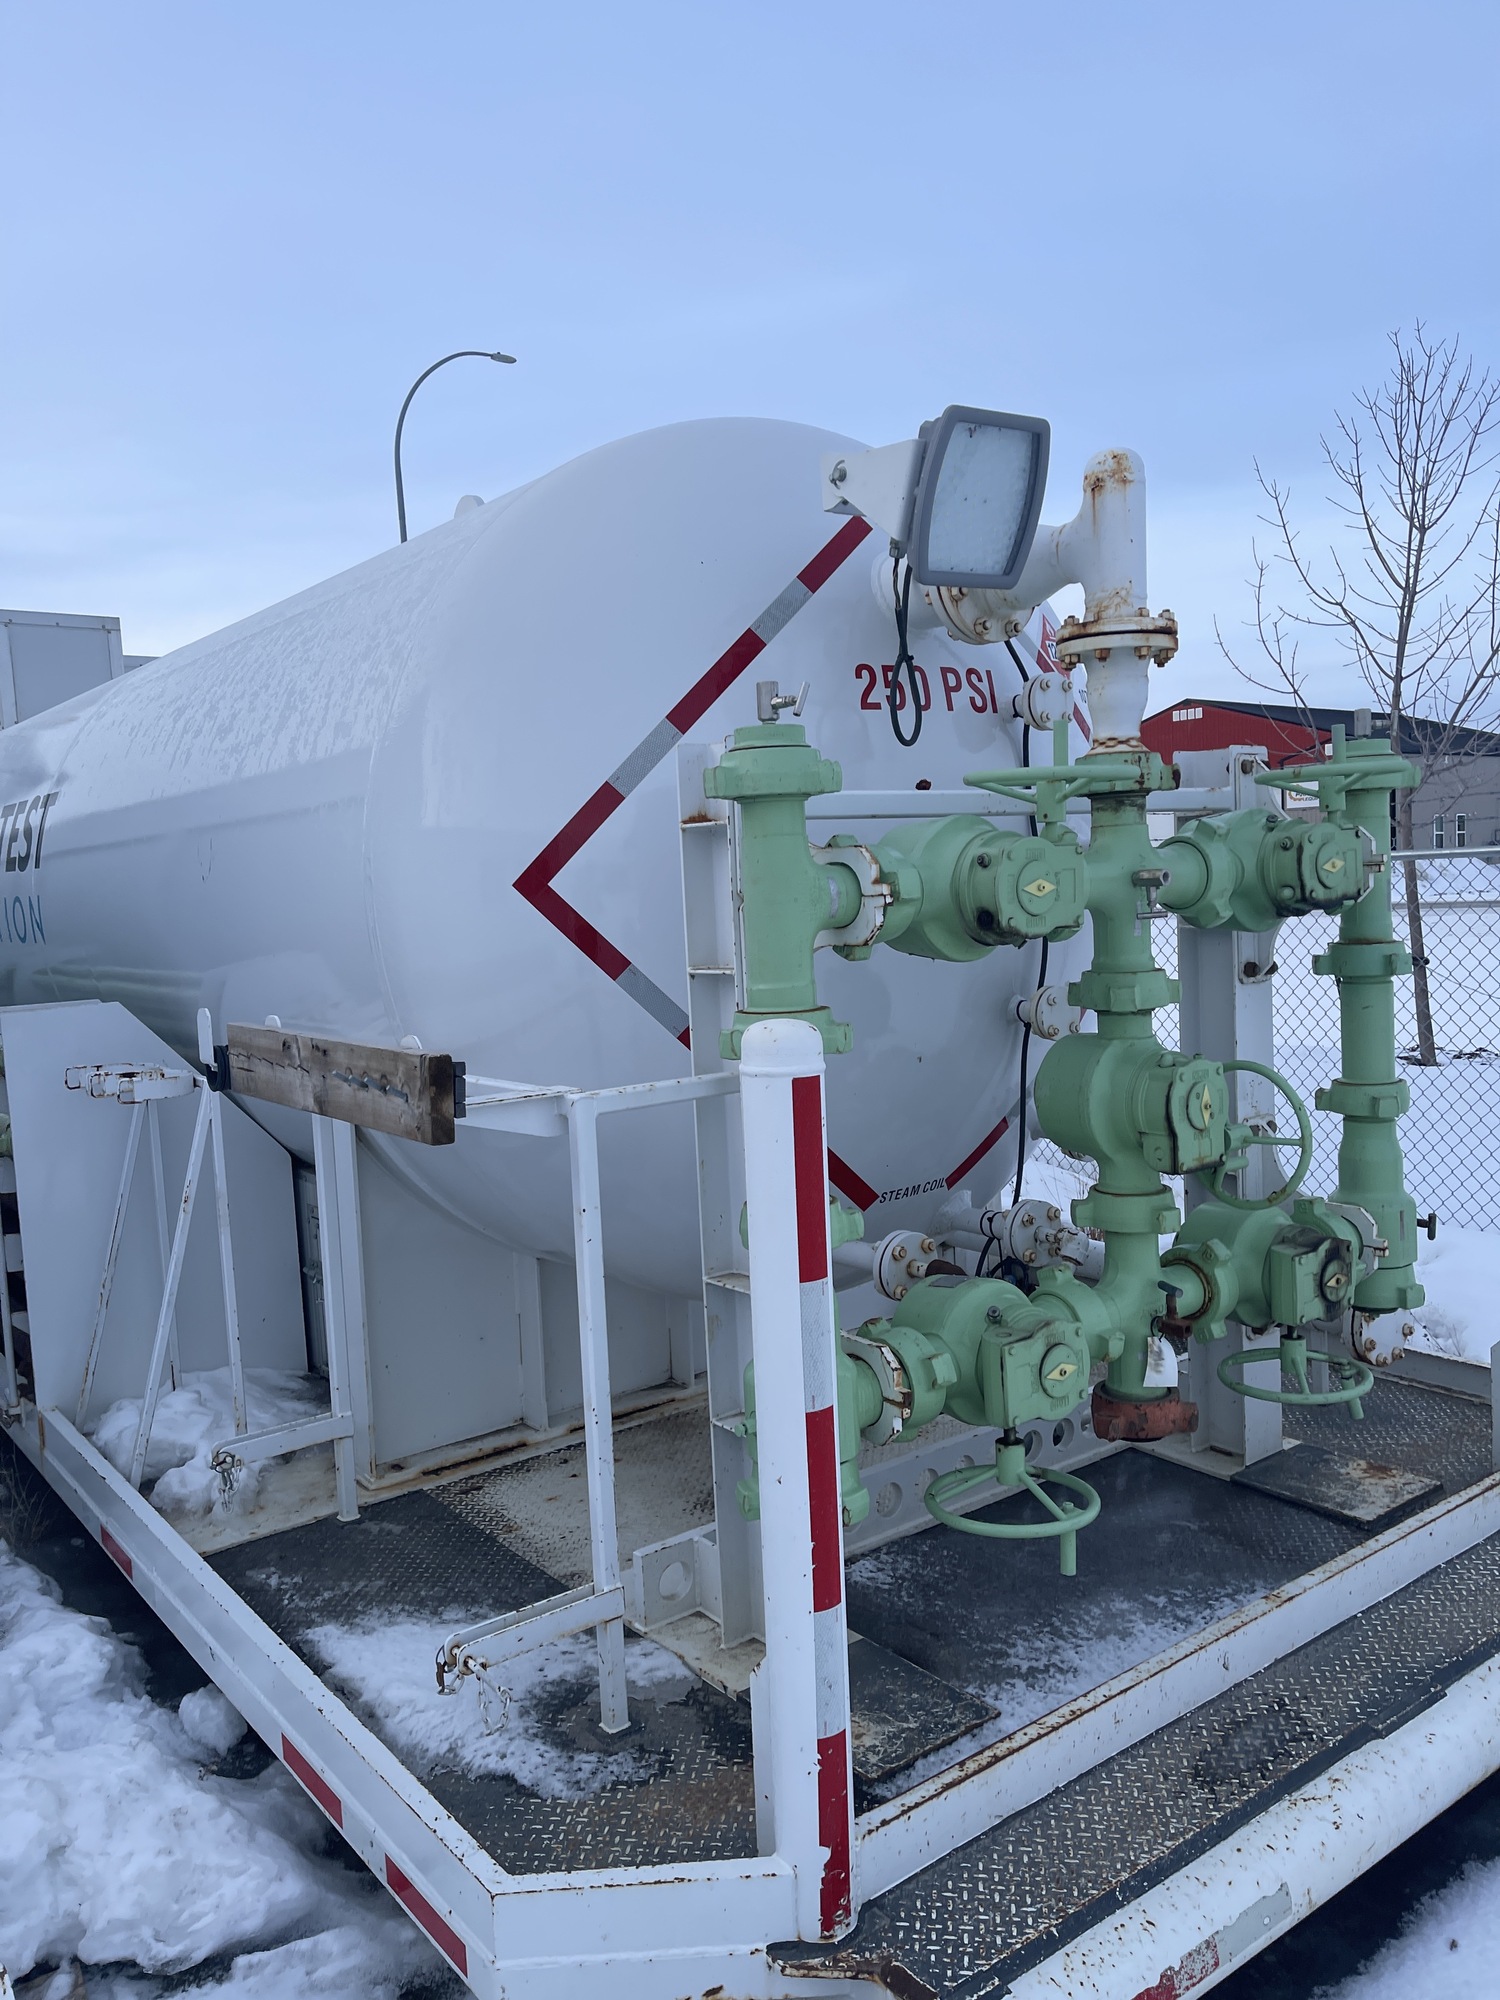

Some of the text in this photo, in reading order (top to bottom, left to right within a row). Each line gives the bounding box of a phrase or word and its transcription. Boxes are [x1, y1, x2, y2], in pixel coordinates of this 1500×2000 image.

[855, 663, 998, 714] 250 PSI
[0, 792, 59, 873] TEST
[0, 895, 46, 945] ION
[880, 1177, 945, 1203] STEAM COIL
